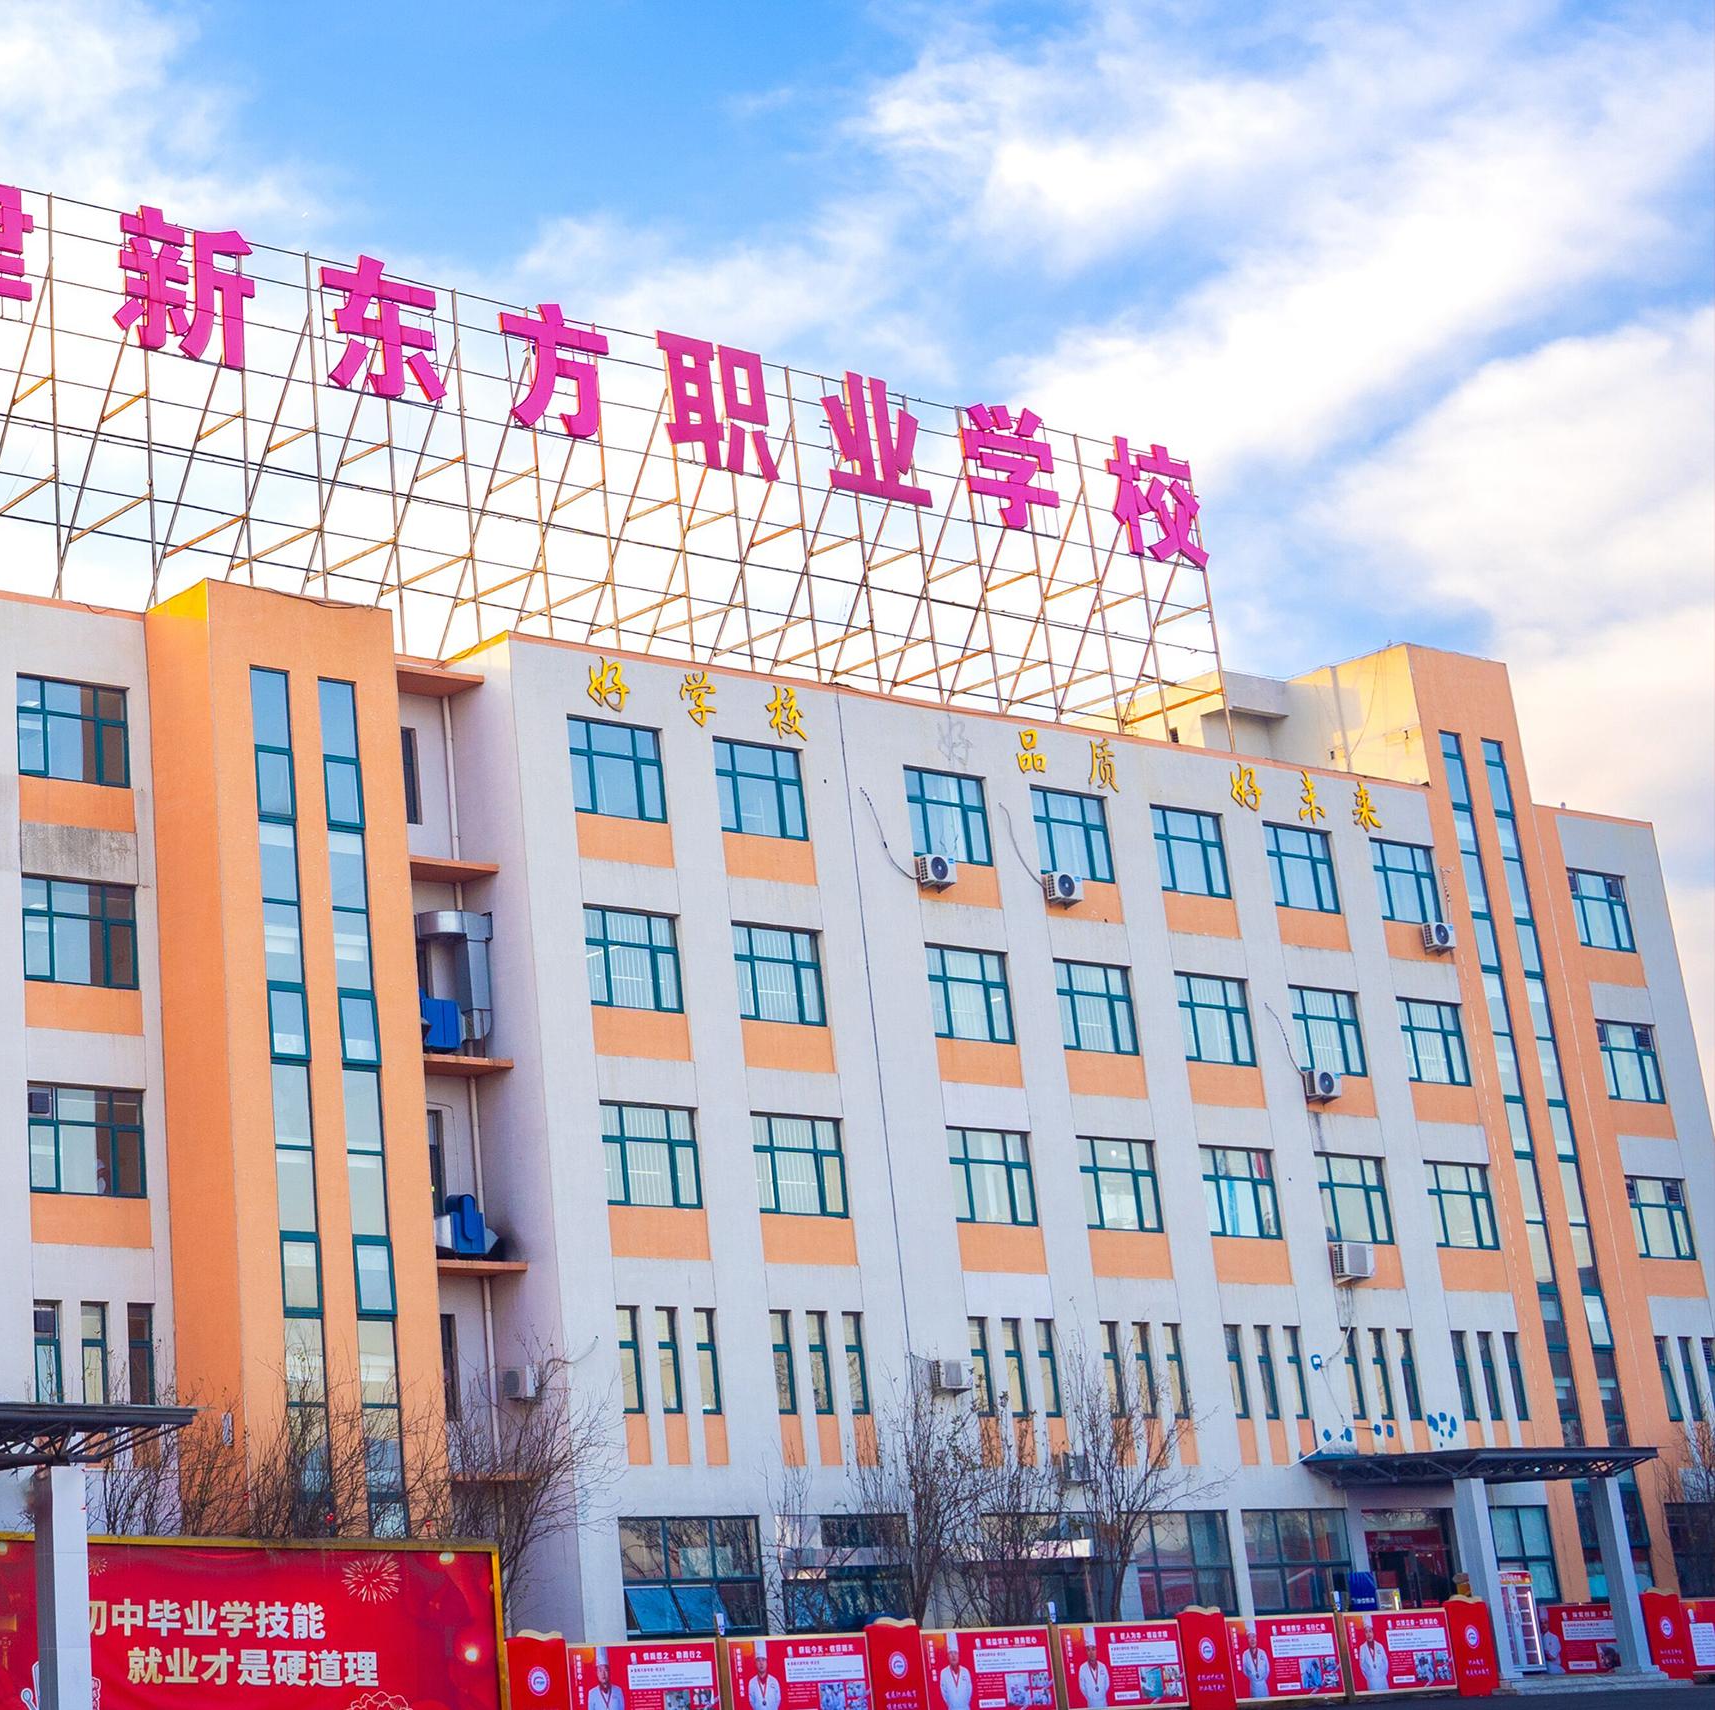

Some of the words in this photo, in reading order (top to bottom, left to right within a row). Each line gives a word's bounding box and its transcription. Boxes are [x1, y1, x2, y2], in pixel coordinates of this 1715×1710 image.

[587, 656, 809, 741] 好学校
[1230, 763, 1383, 832] 好未来
[127, 1646, 379, 1688] 就业才是硬道理
